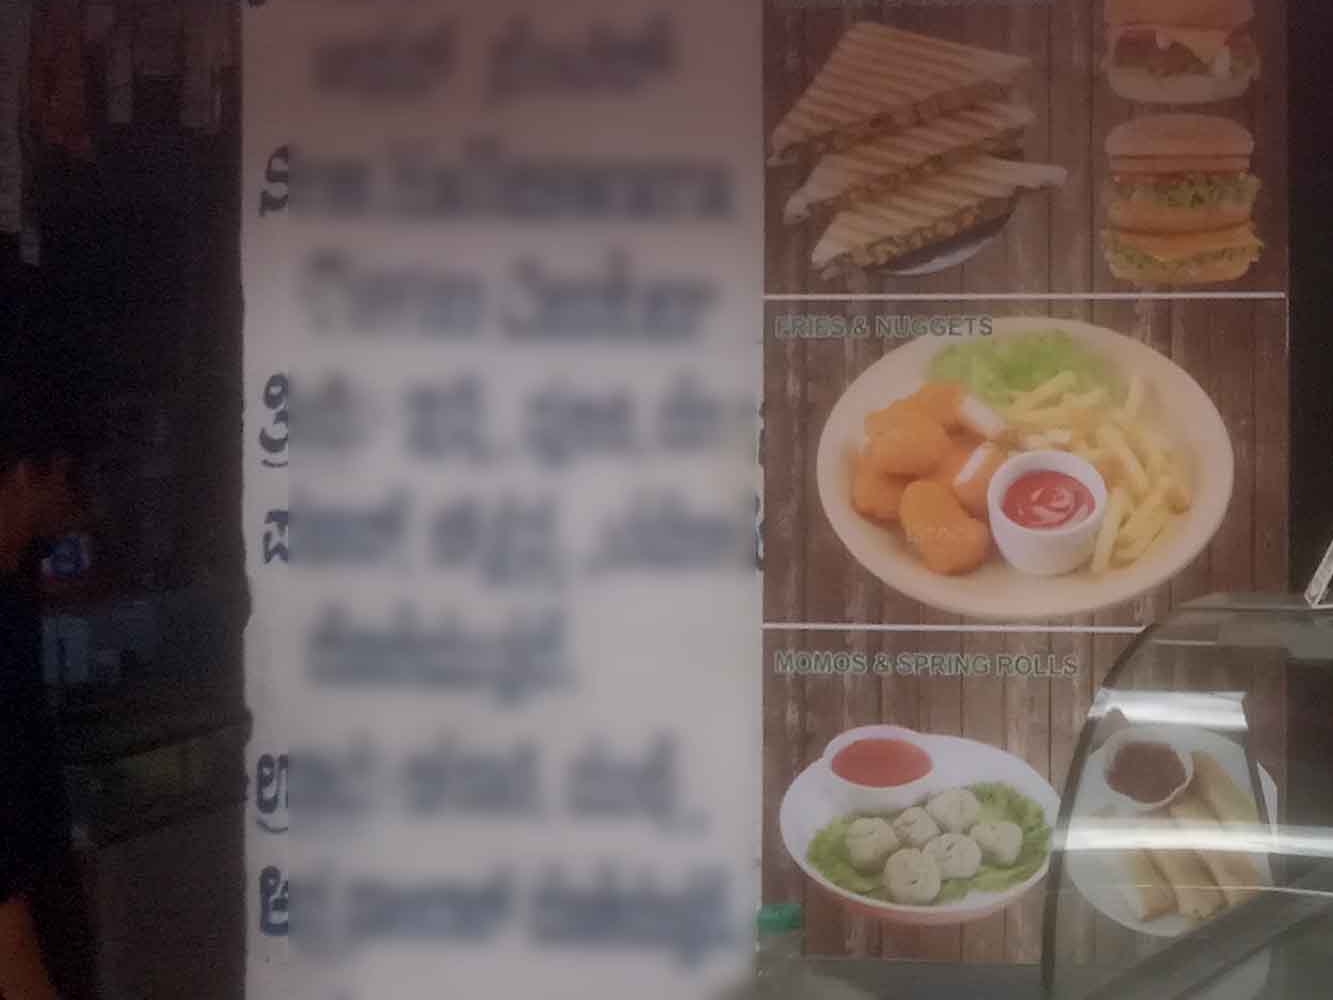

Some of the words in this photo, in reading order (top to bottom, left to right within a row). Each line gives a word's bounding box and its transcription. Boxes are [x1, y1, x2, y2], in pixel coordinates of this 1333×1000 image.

[775, 312, 847, 338] FRIES
[851, 313, 868, 337] &
[874, 312, 993, 337] NUGGETS
[775, 650, 867, 674] MOMOS
[872, 651, 890, 674] &
[896, 651, 990, 675] SPRING
[996, 652, 1079, 676] ROLLS
